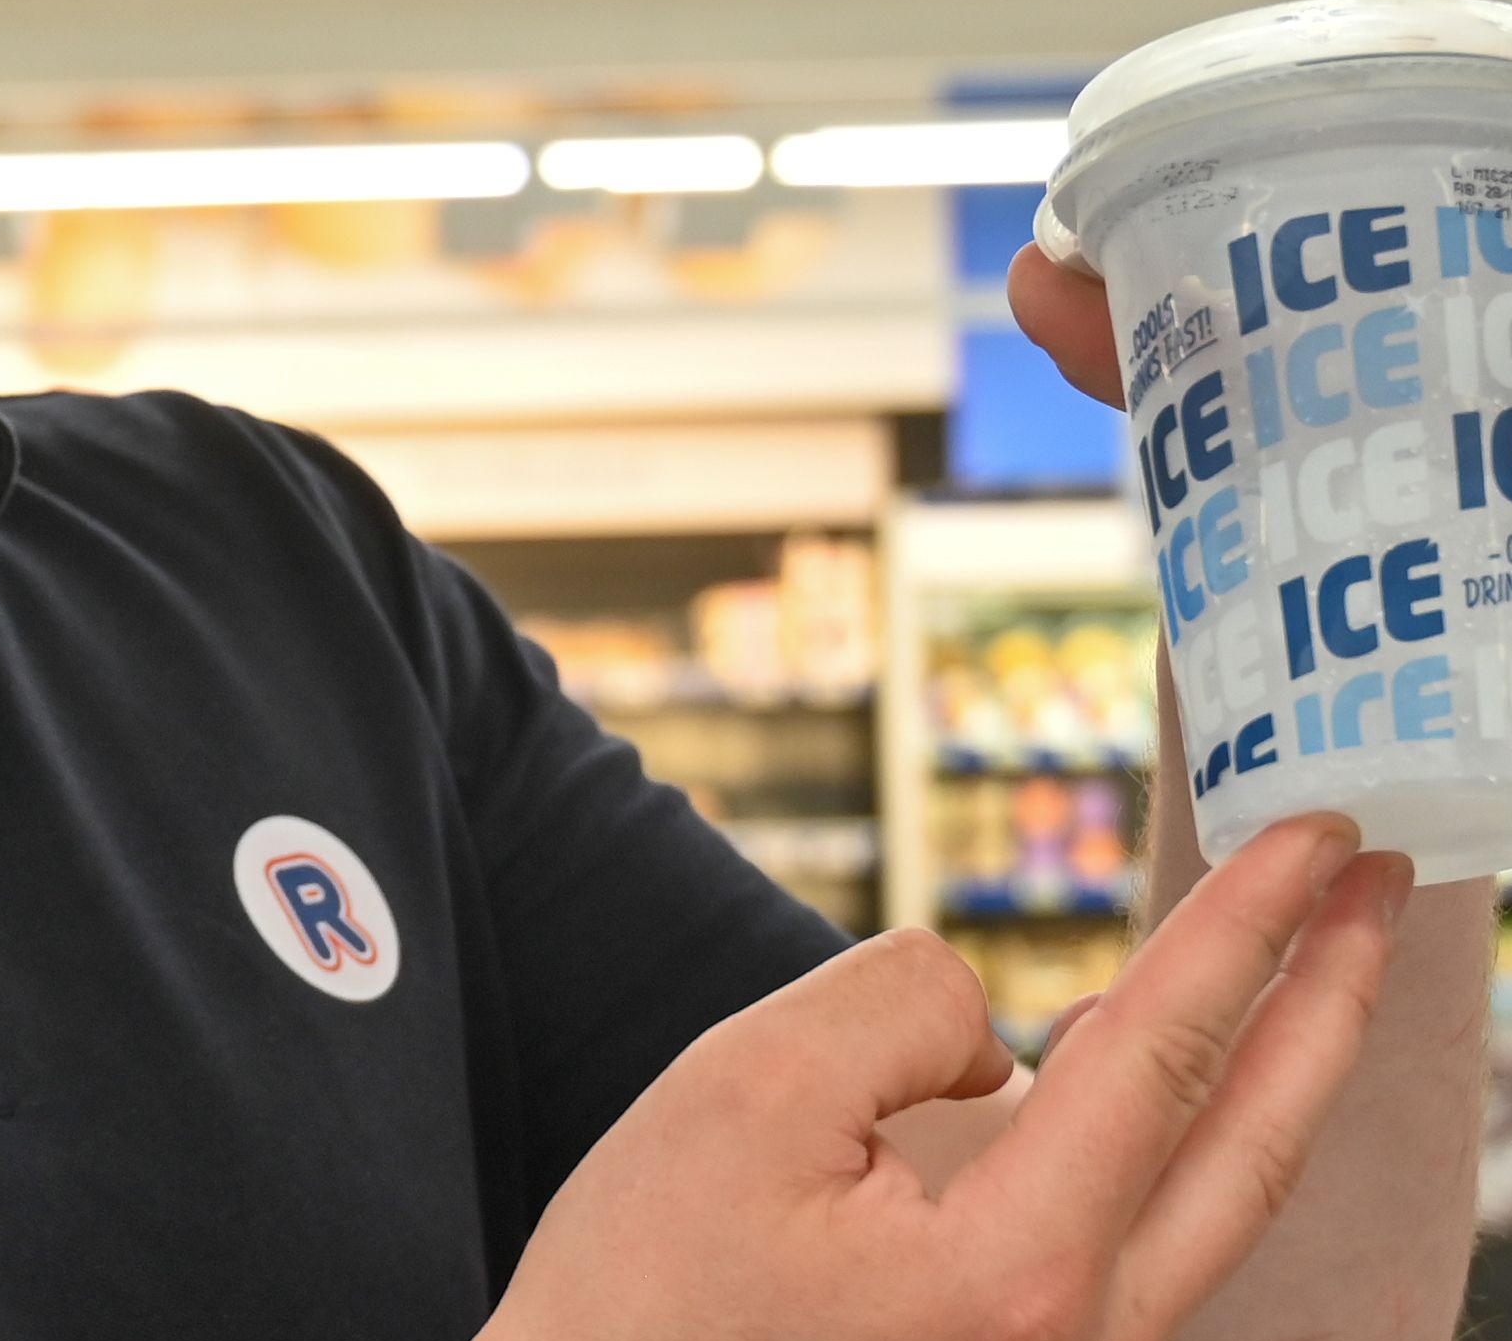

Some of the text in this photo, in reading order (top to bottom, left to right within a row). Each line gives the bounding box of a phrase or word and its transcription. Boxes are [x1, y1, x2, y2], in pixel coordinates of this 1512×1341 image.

[1228, 206, 1411, 336] ICE
[1244, 305, 1424, 450] ICE
[1139, 370, 1233, 536] ICE
[1259, 419, 1431, 563] ICE
[1156, 484, 1248, 648] ICE
[1279, 538, 1446, 681] ICE
[1295, 654, 1454, 755] ICE
[265, 853, 378, 972] R
